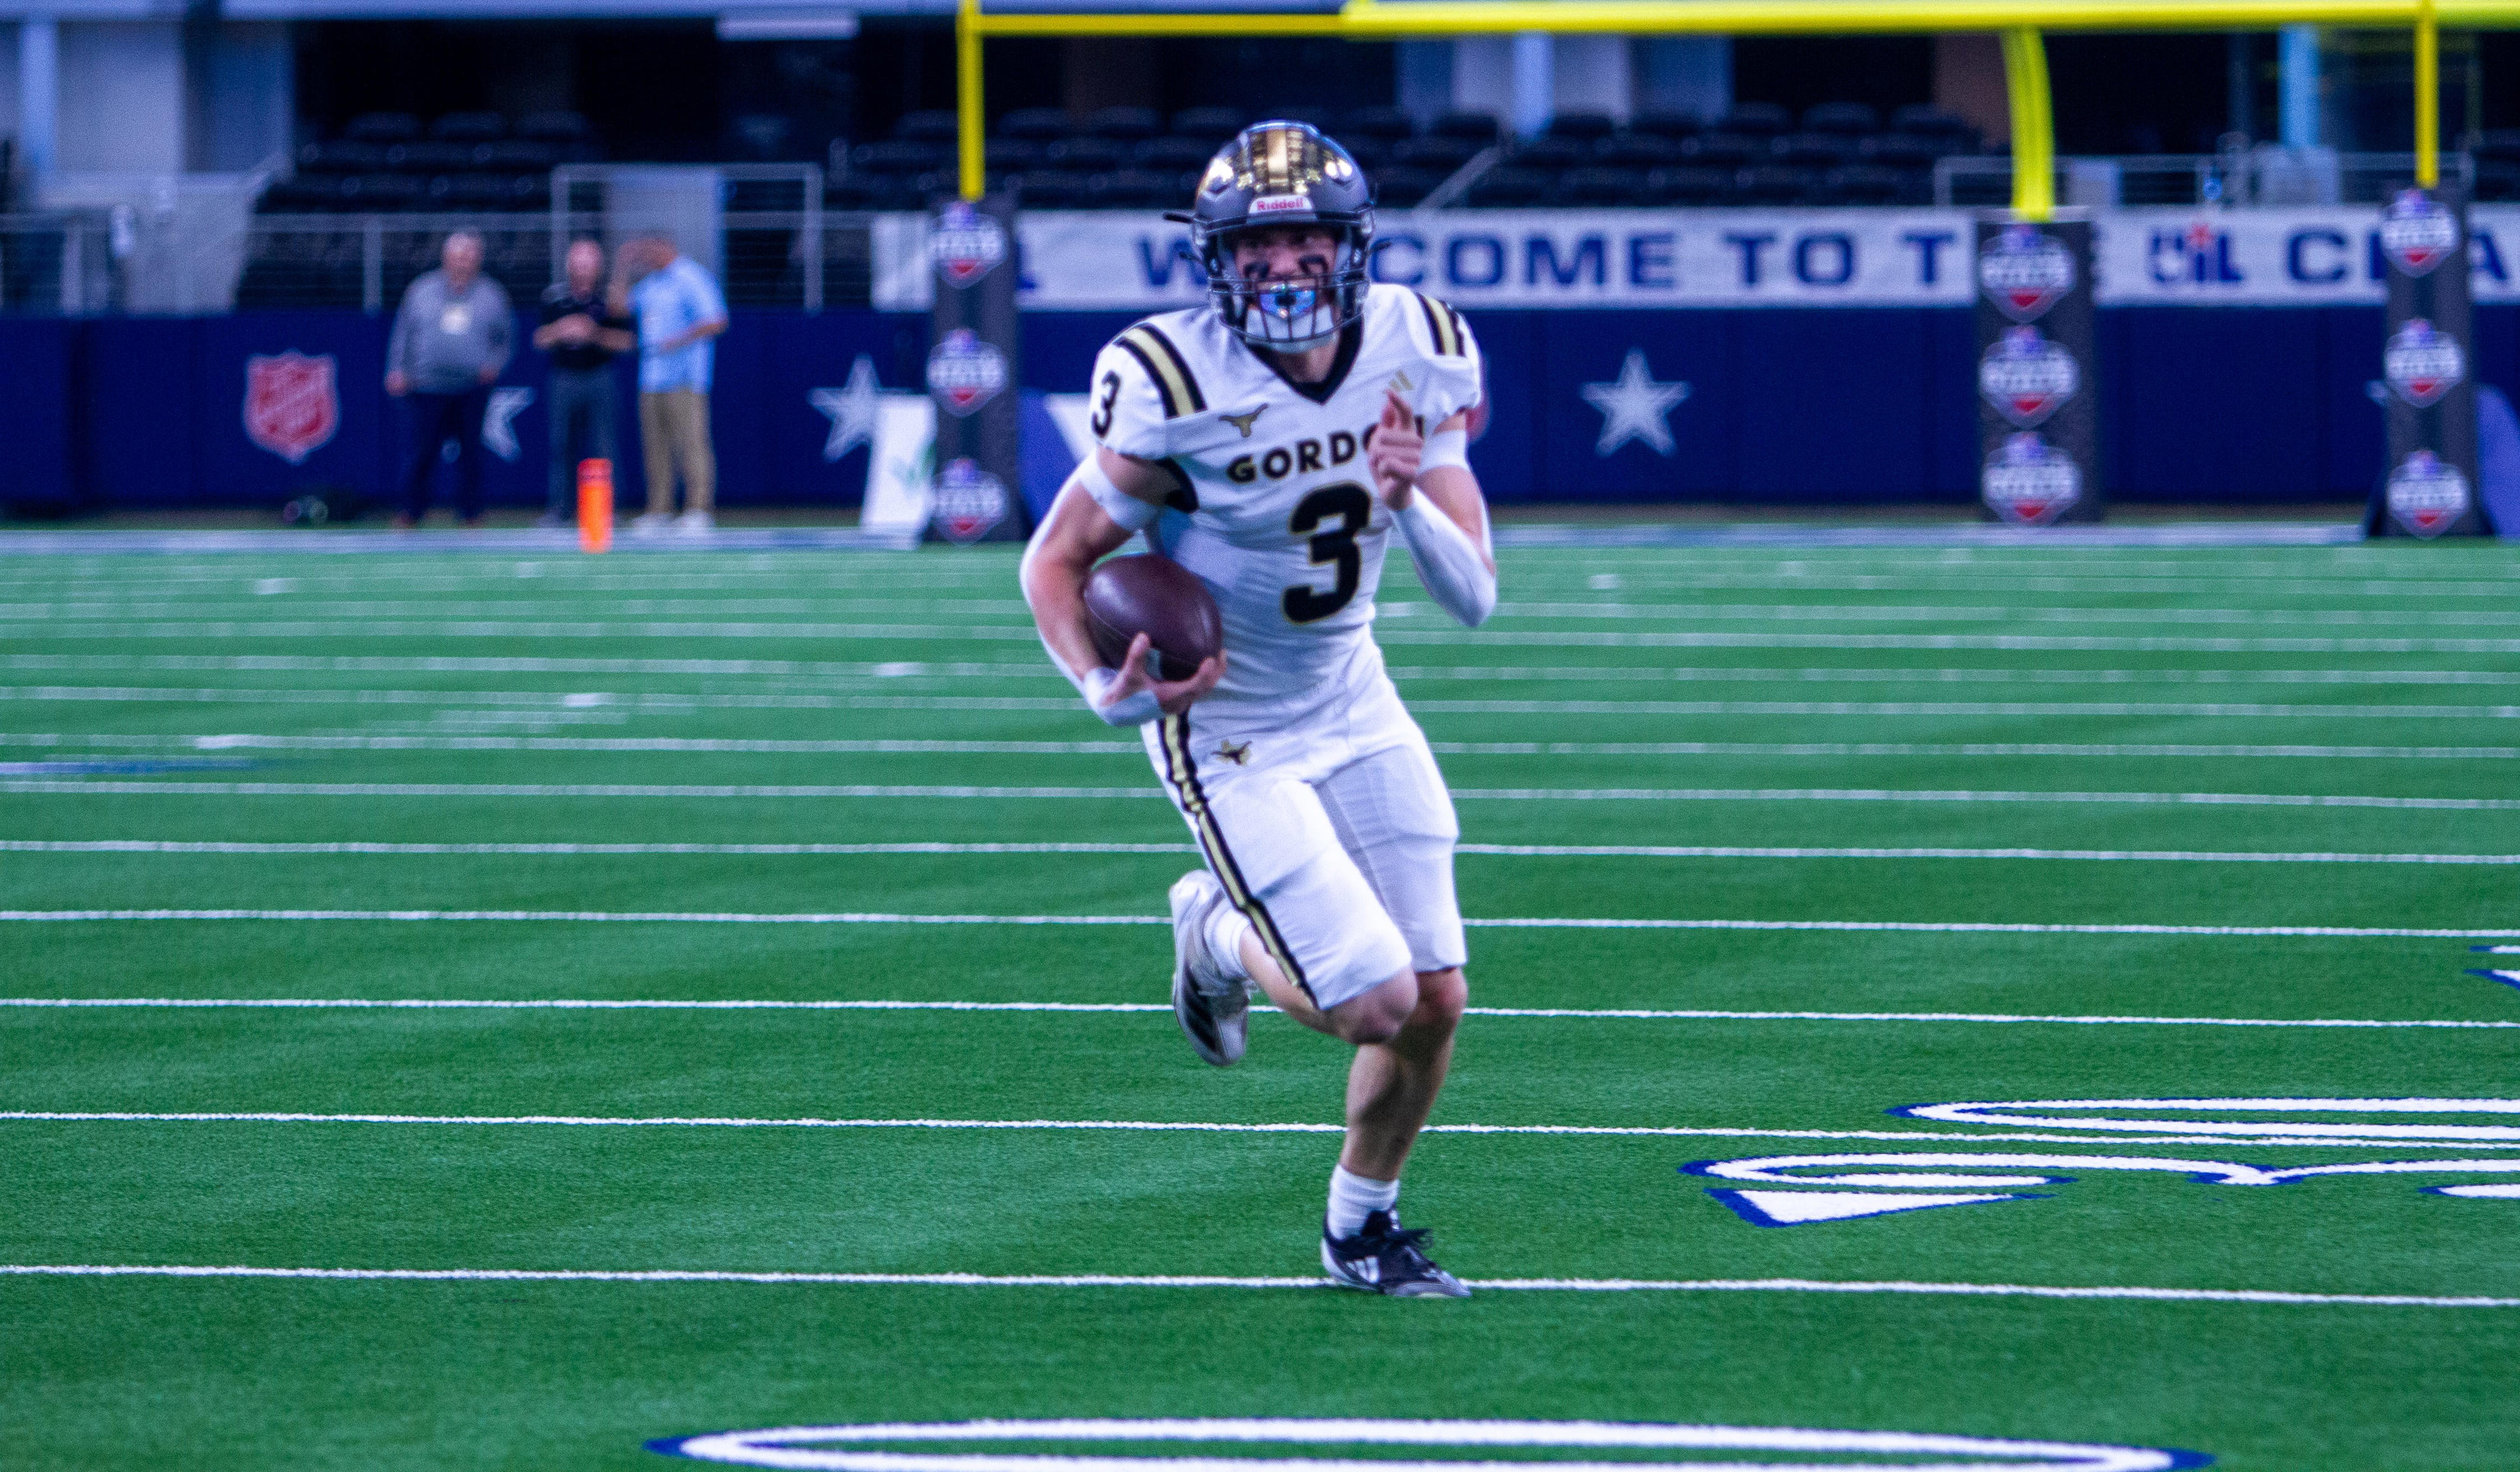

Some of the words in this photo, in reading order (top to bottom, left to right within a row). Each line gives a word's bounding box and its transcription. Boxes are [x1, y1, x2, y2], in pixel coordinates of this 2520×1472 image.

[1256, 197, 1304, 211] Riddell
[1137, 232, 1675, 288] WCOME
[1722, 233, 1853, 288] TO
[1091, 370, 1121, 438] 3
[1226, 414, 1424, 484] GORD
[1280, 481, 1374, 625] 3
